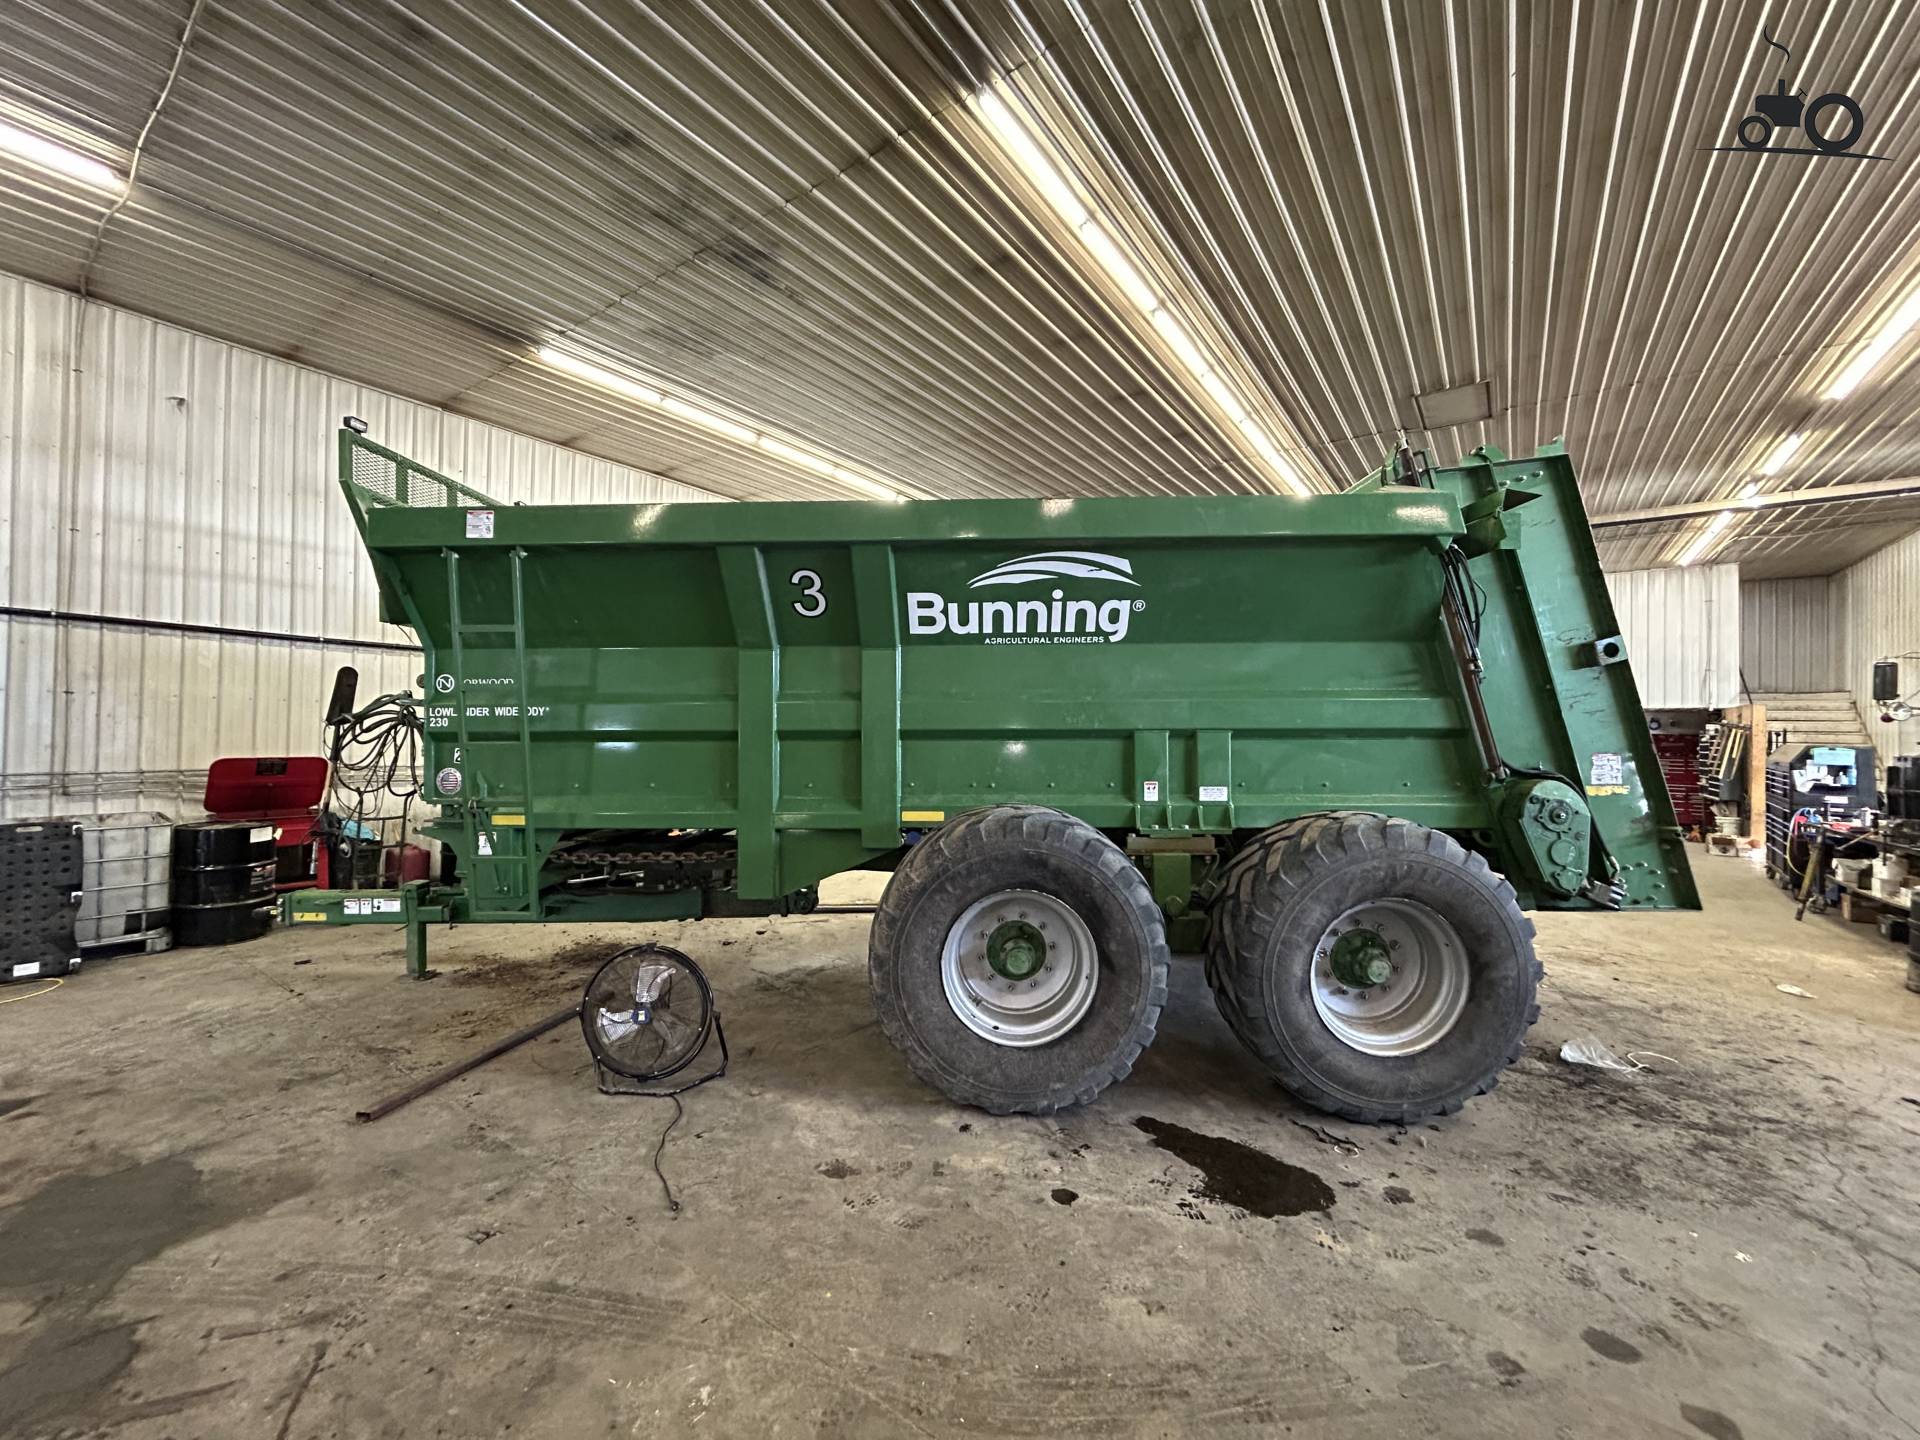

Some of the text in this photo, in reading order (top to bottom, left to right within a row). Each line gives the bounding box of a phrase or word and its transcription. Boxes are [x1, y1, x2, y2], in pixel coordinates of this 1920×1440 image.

[790, 569, 826, 617] 3
[1053, 636, 1105, 644] ENGINEERS
[429, 706, 490, 717] LOWLDER
[429, 717, 449, 727] 230
